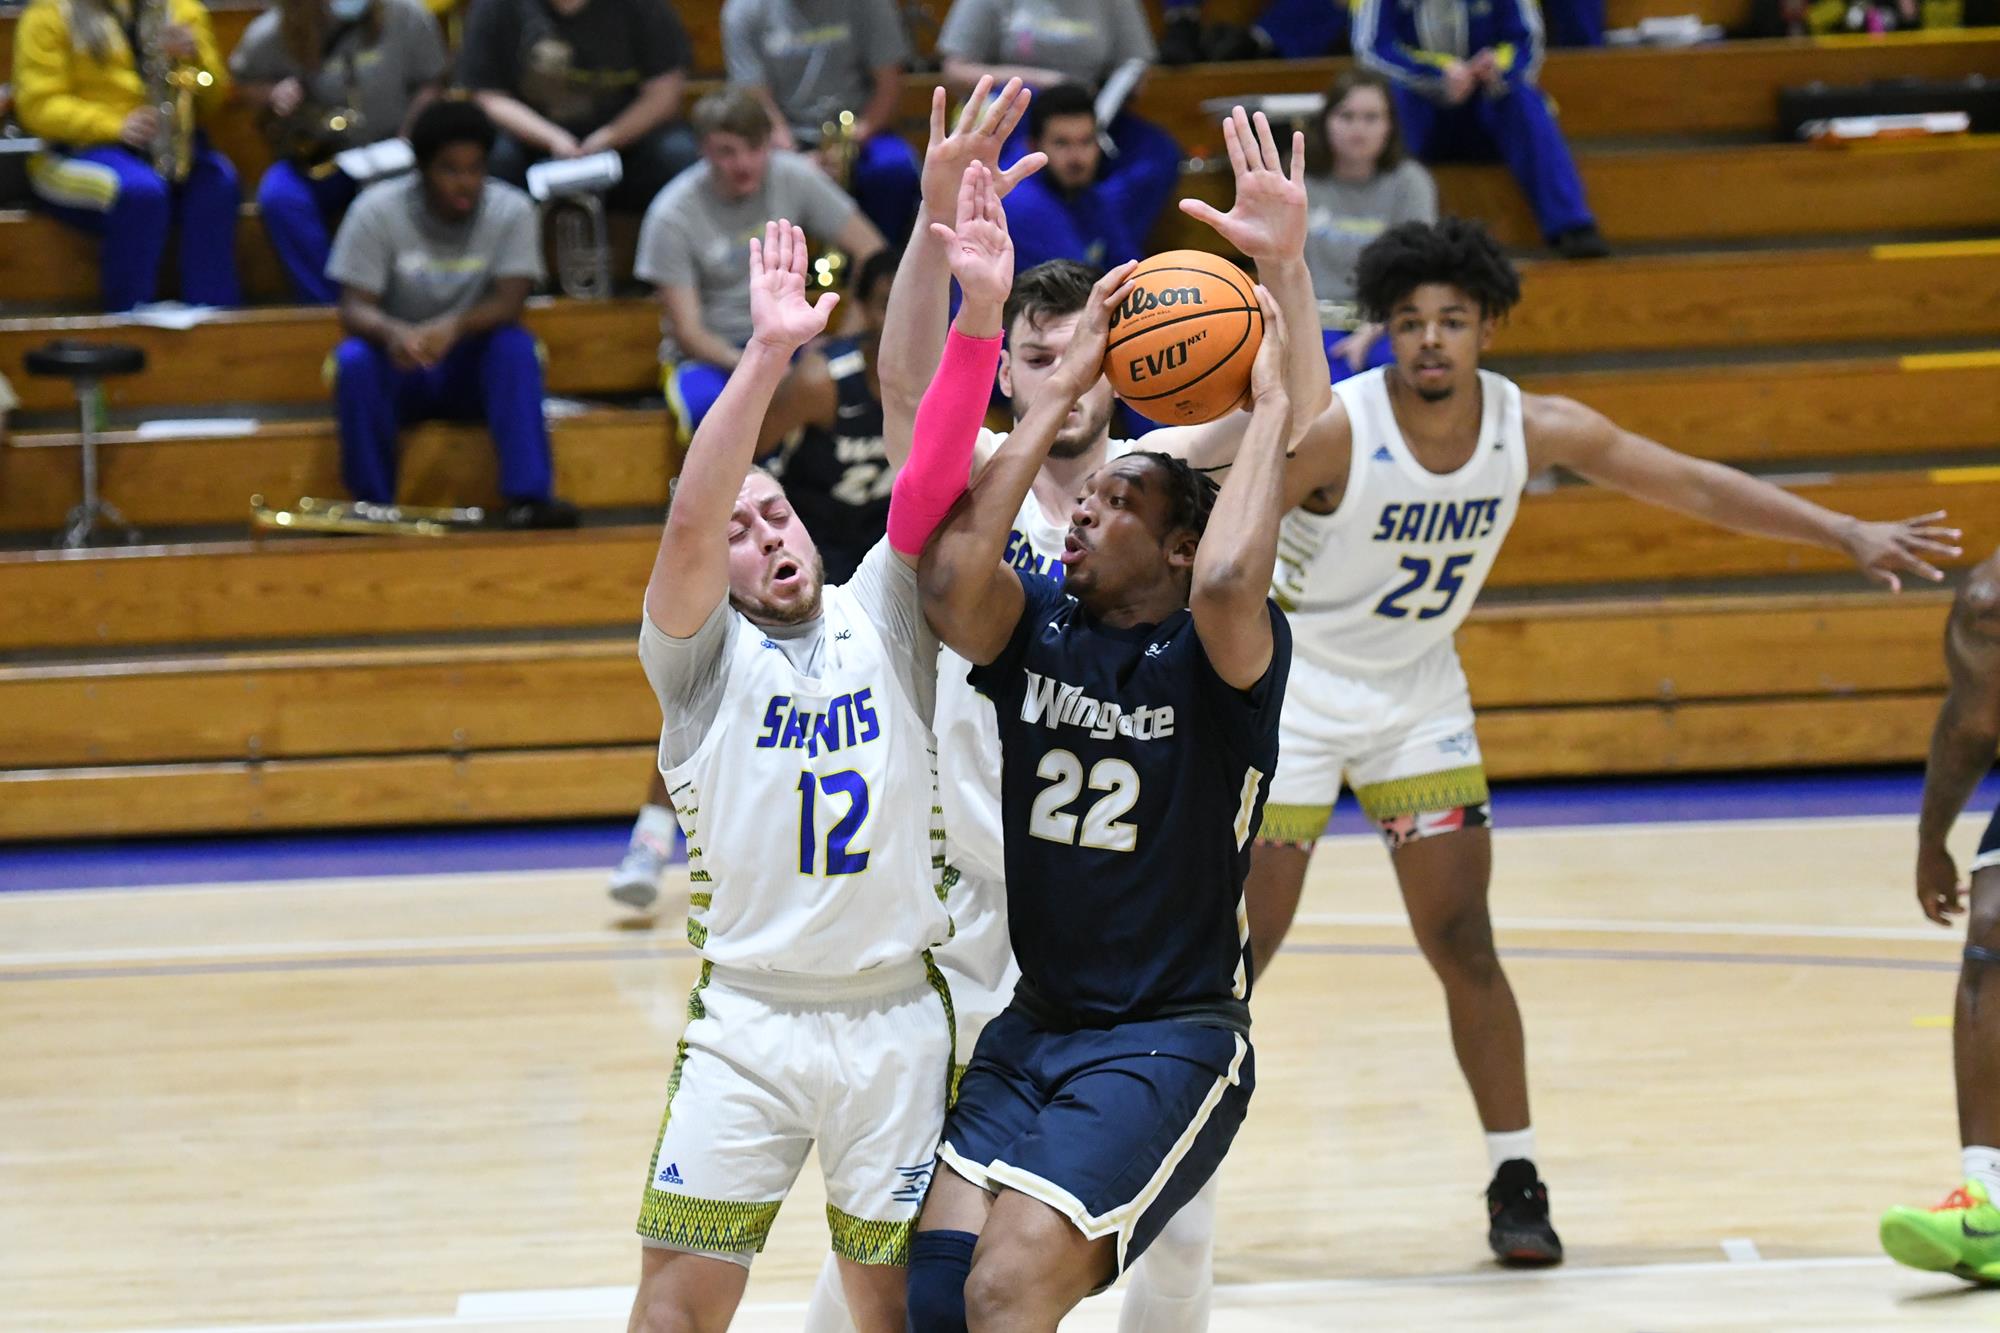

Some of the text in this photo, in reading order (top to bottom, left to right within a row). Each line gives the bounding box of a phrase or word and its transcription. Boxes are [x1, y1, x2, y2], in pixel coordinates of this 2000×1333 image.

[1109, 287, 1202, 329] ilson
[1187, 329, 1208, 346] NXT
[1372, 497, 1503, 543] SAINTS
[1374, 552, 1475, 620] 25
[756, 687, 880, 759] SAINTS
[1020, 668, 1175, 741] Wingate
[795, 768, 871, 877] 12
[1029, 748, 1141, 853] 22
